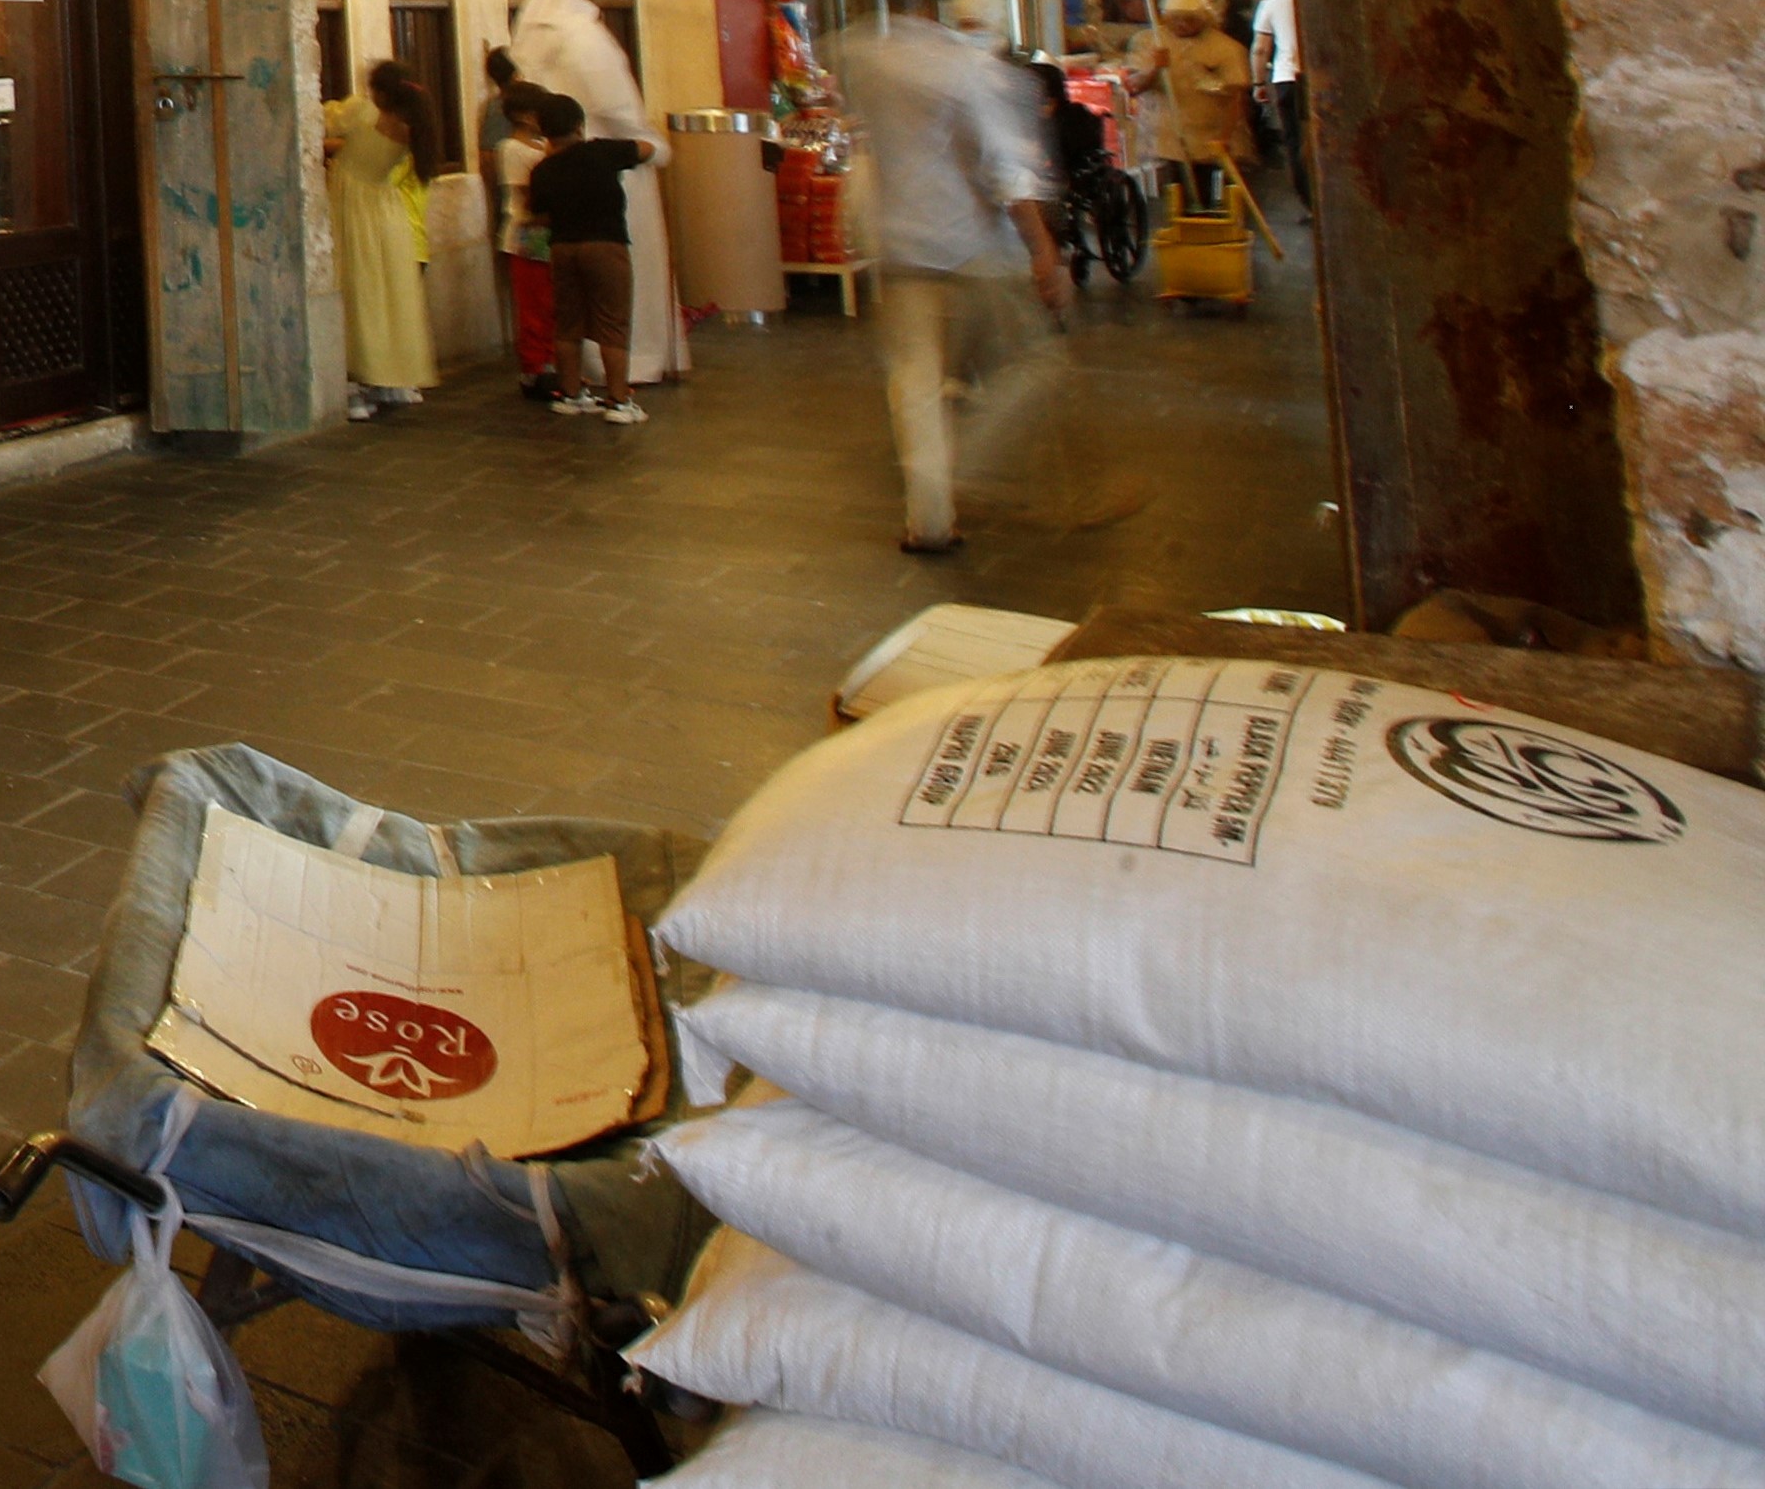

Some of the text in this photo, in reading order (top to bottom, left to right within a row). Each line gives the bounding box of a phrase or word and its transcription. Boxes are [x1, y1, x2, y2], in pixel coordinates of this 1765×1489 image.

[1040, 728, 1077, 760] JUNE
[1092, 729, 1129, 760] JUNE
[1241, 713, 1281, 760] BLACK
[1129, 738, 1181, 795] VIETNAM
[1219, 761, 1269, 814] PEPPER
